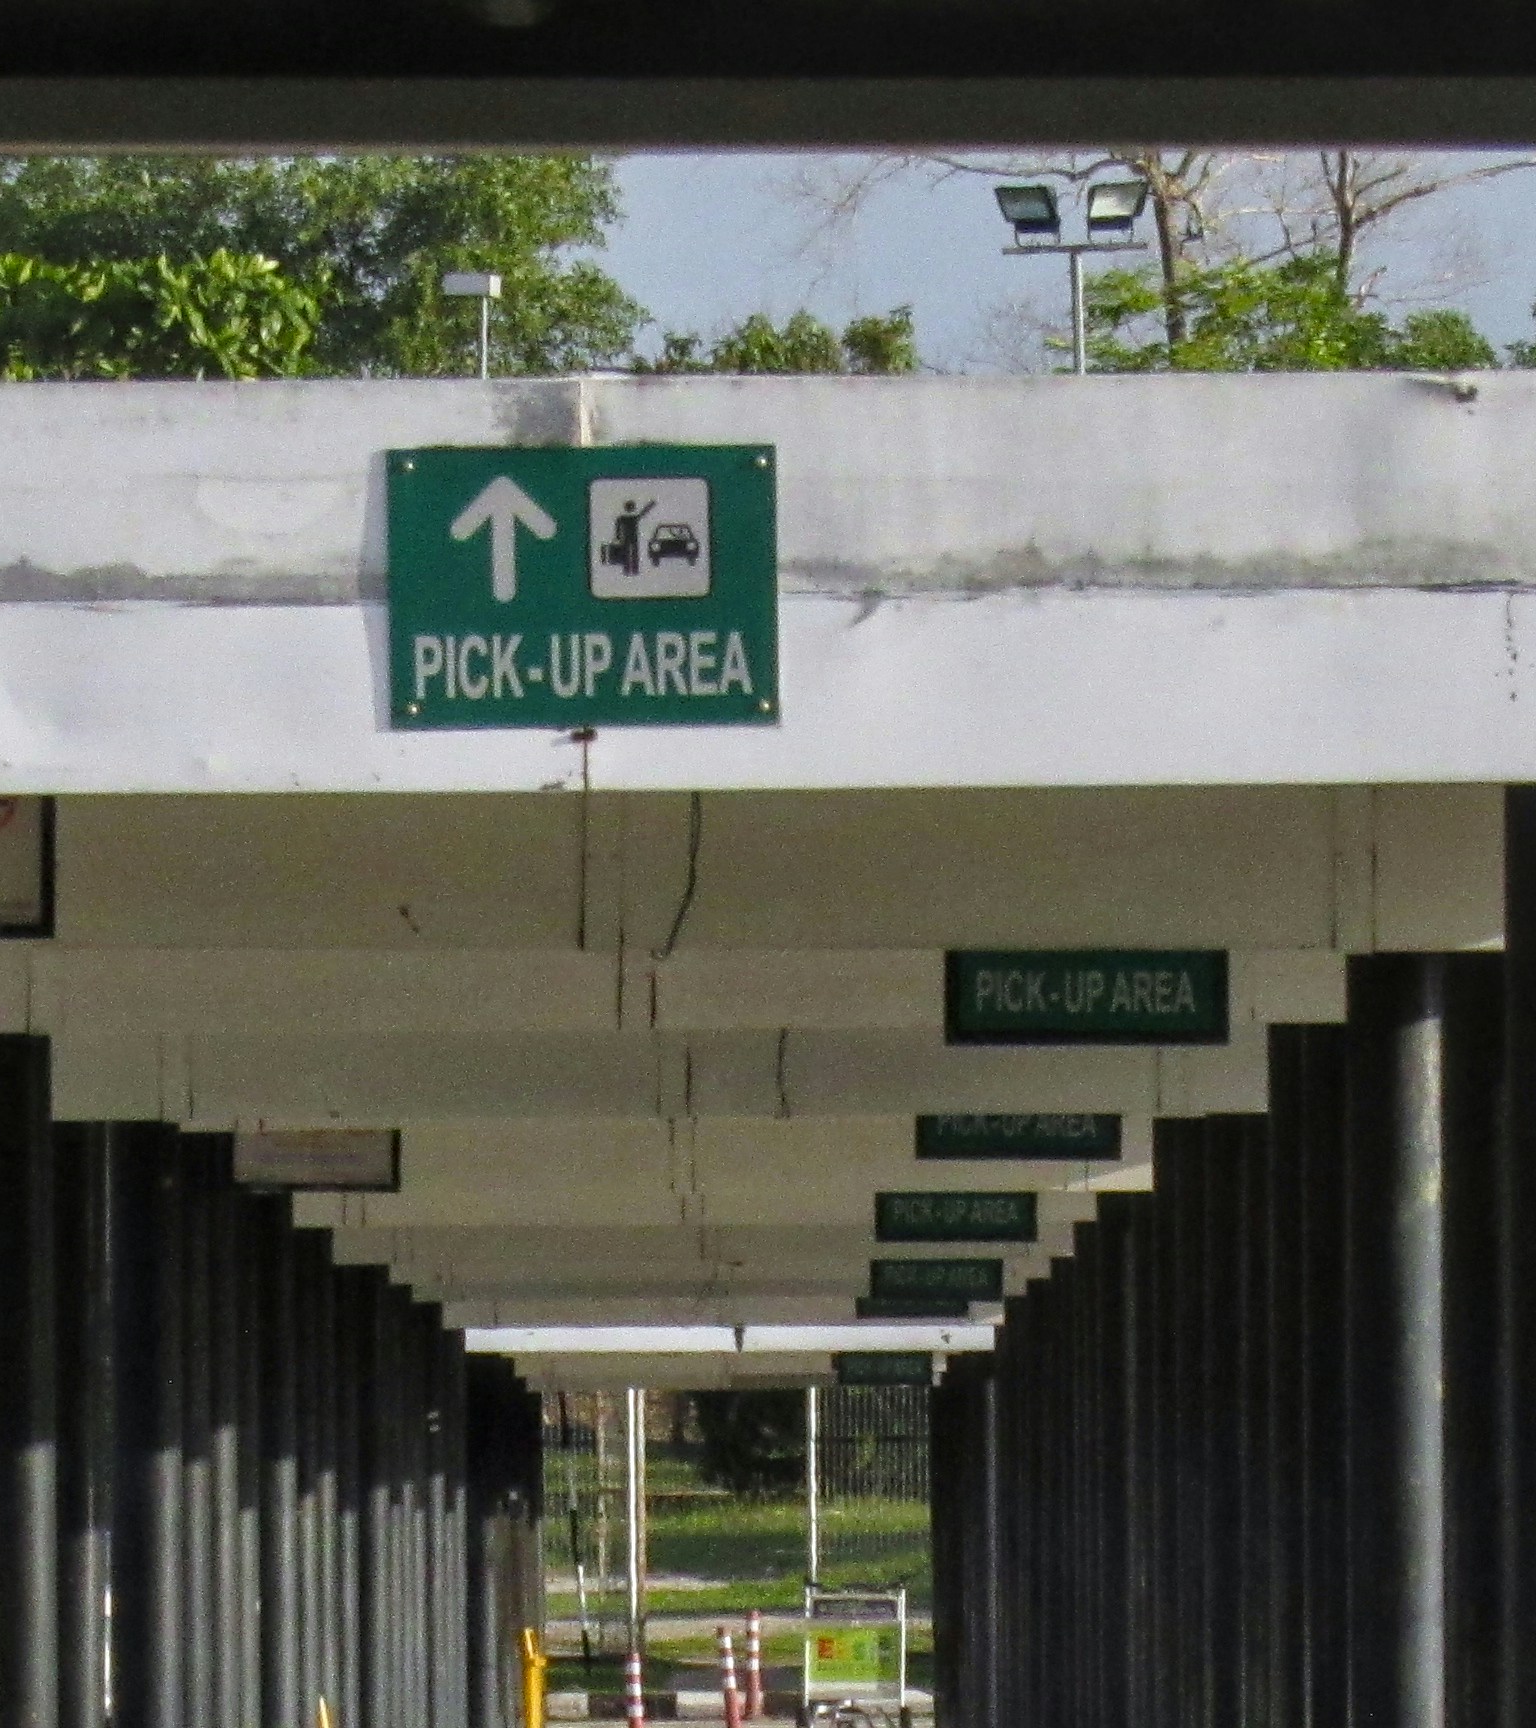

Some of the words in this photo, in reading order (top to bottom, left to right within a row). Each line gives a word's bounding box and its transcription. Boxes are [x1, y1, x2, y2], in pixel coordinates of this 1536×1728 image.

[413, 633, 613, 699] PICK-UP
[619, 631, 754, 697] AREA
[974, 968, 1105, 1014] PICK-UP
[1110, 968, 1197, 1014] AREA
